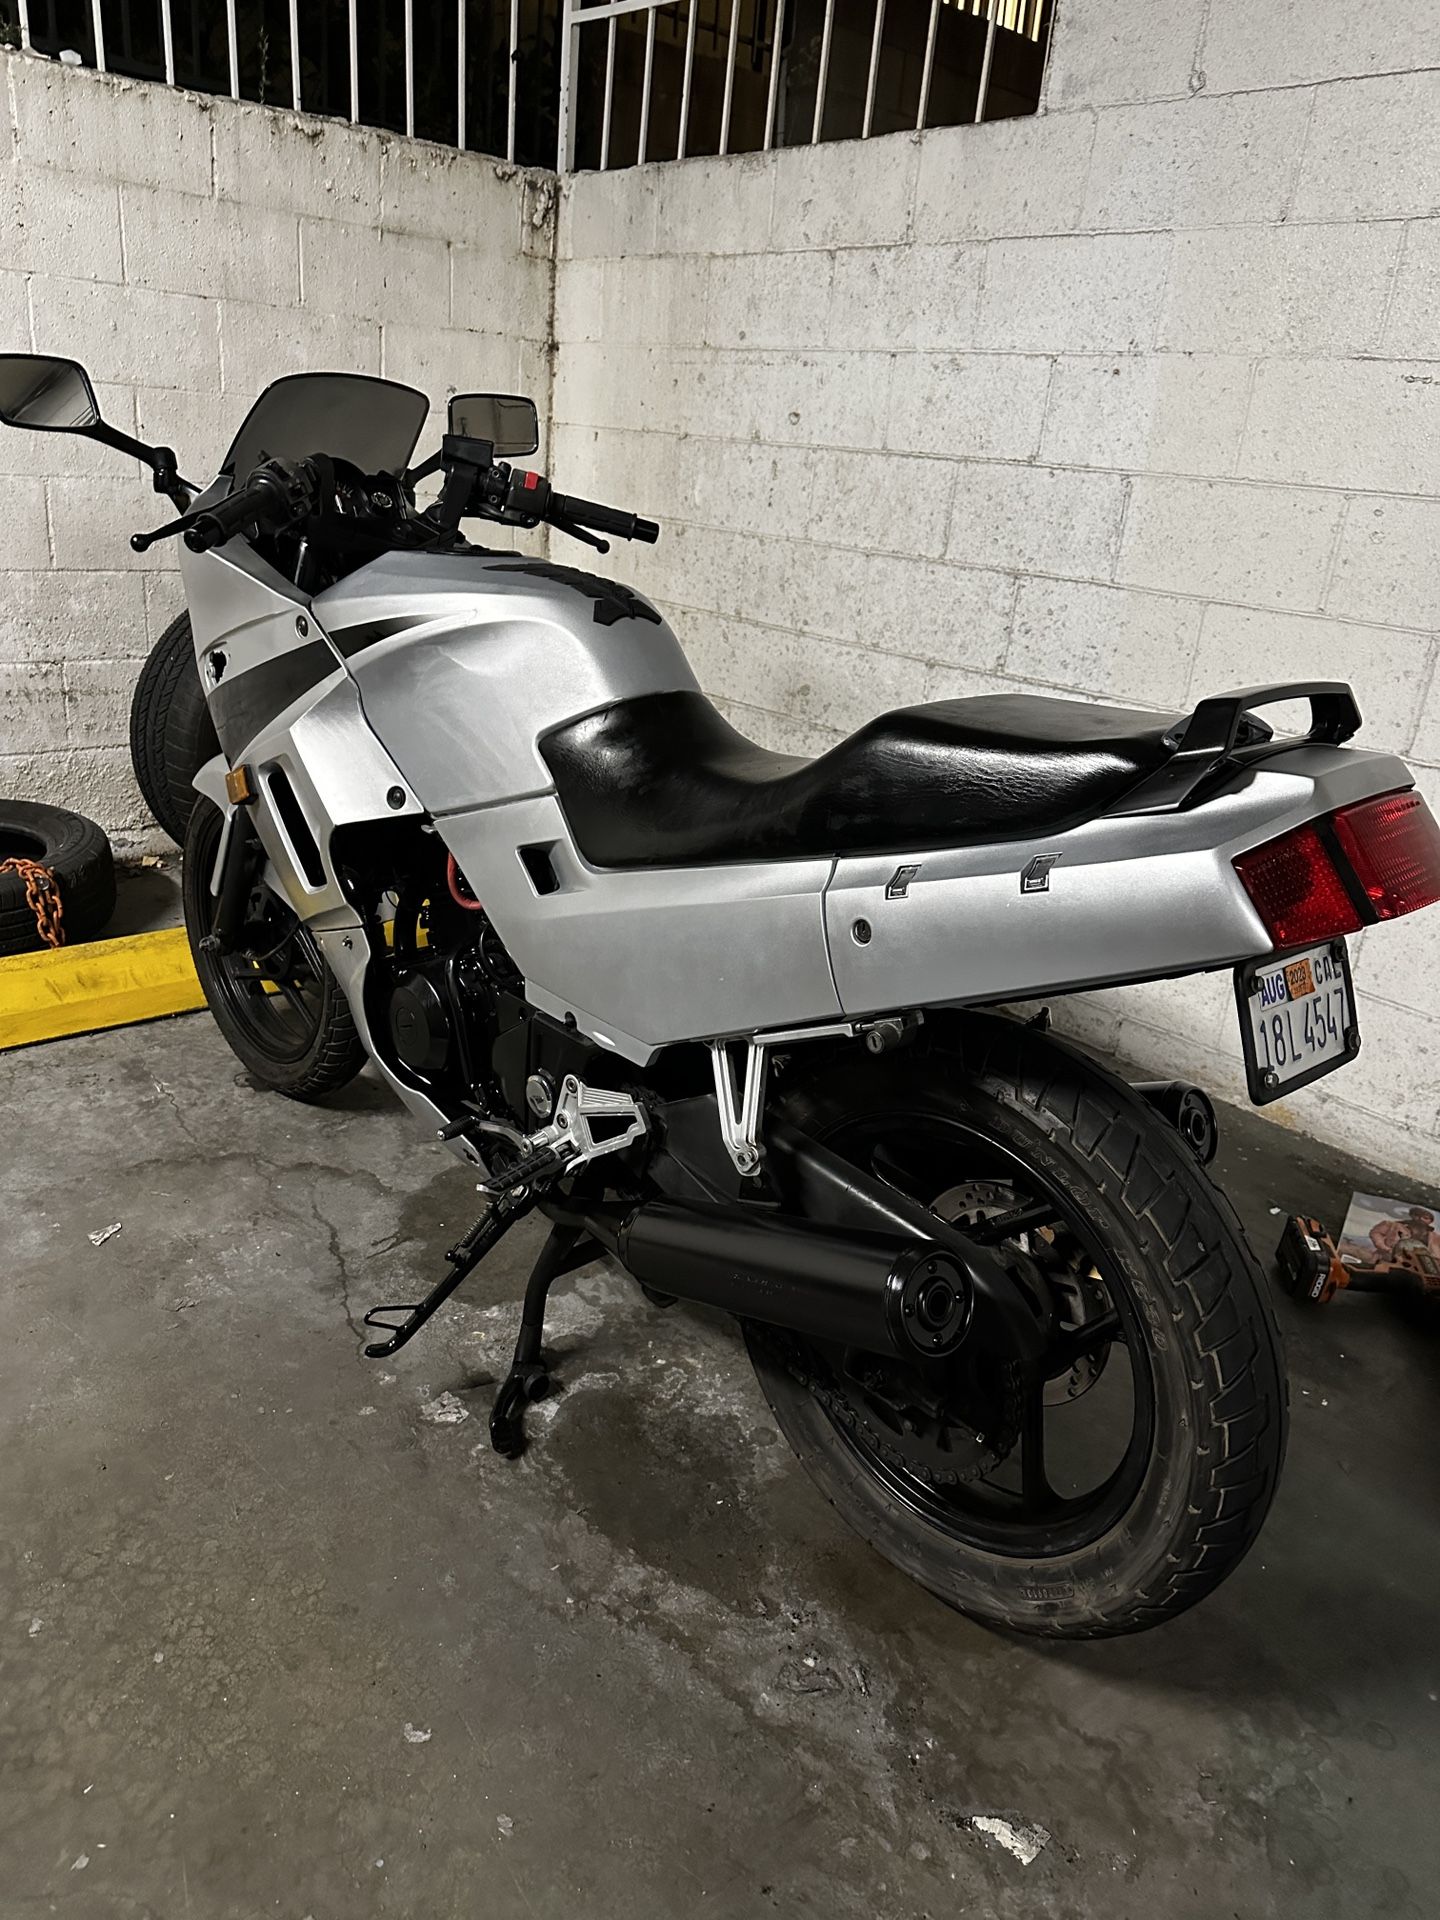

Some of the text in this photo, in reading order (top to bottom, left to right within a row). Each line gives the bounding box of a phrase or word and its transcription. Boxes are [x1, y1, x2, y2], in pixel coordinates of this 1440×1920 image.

[1261, 974, 1285, 1006] AUG
[1314, 956, 1342, 984] CAL
[1260, 987, 1346, 1071] 18L 4547
